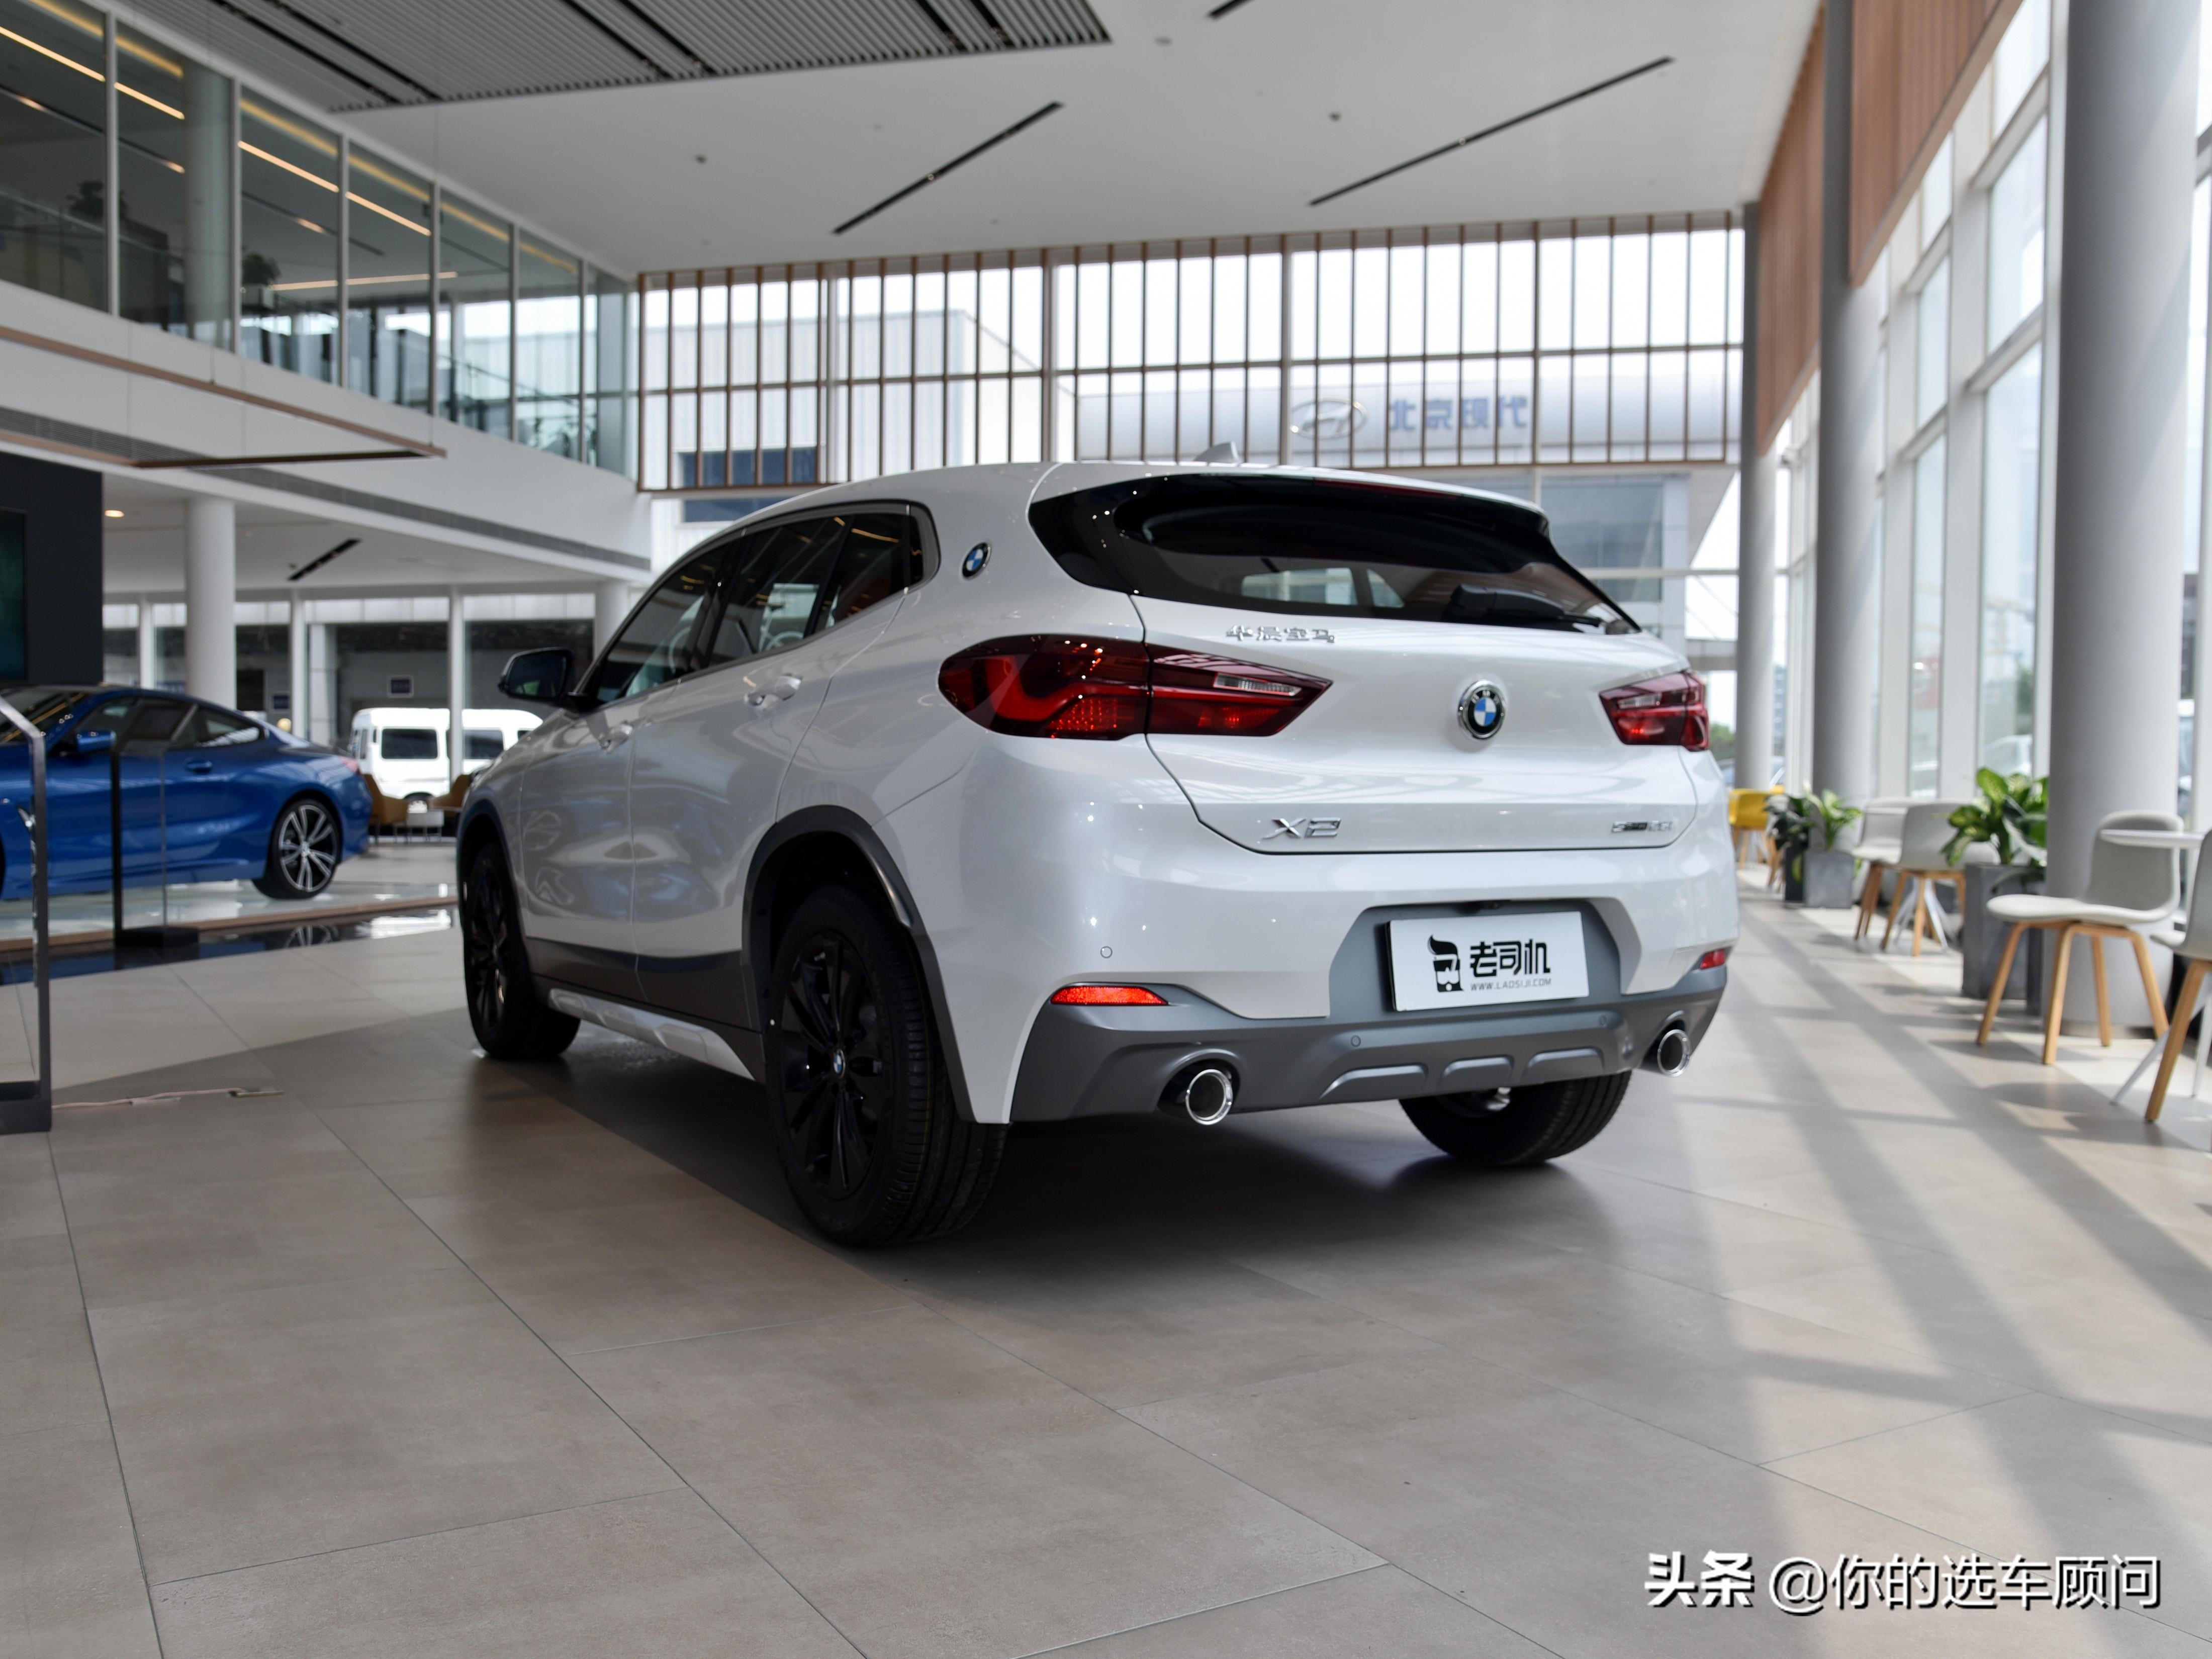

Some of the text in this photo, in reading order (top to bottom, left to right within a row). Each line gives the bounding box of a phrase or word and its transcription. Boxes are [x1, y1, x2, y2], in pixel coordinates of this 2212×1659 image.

[1391, 396, 1528, 431] 北京现代
[1226, 625, 1336, 643] 华晨宝马
[1261, 817, 1342, 839] X2
[1470, 939, 1551, 977] 老司机
[1470, 978, 1551, 992] WWW.LAOSIJI.COM
